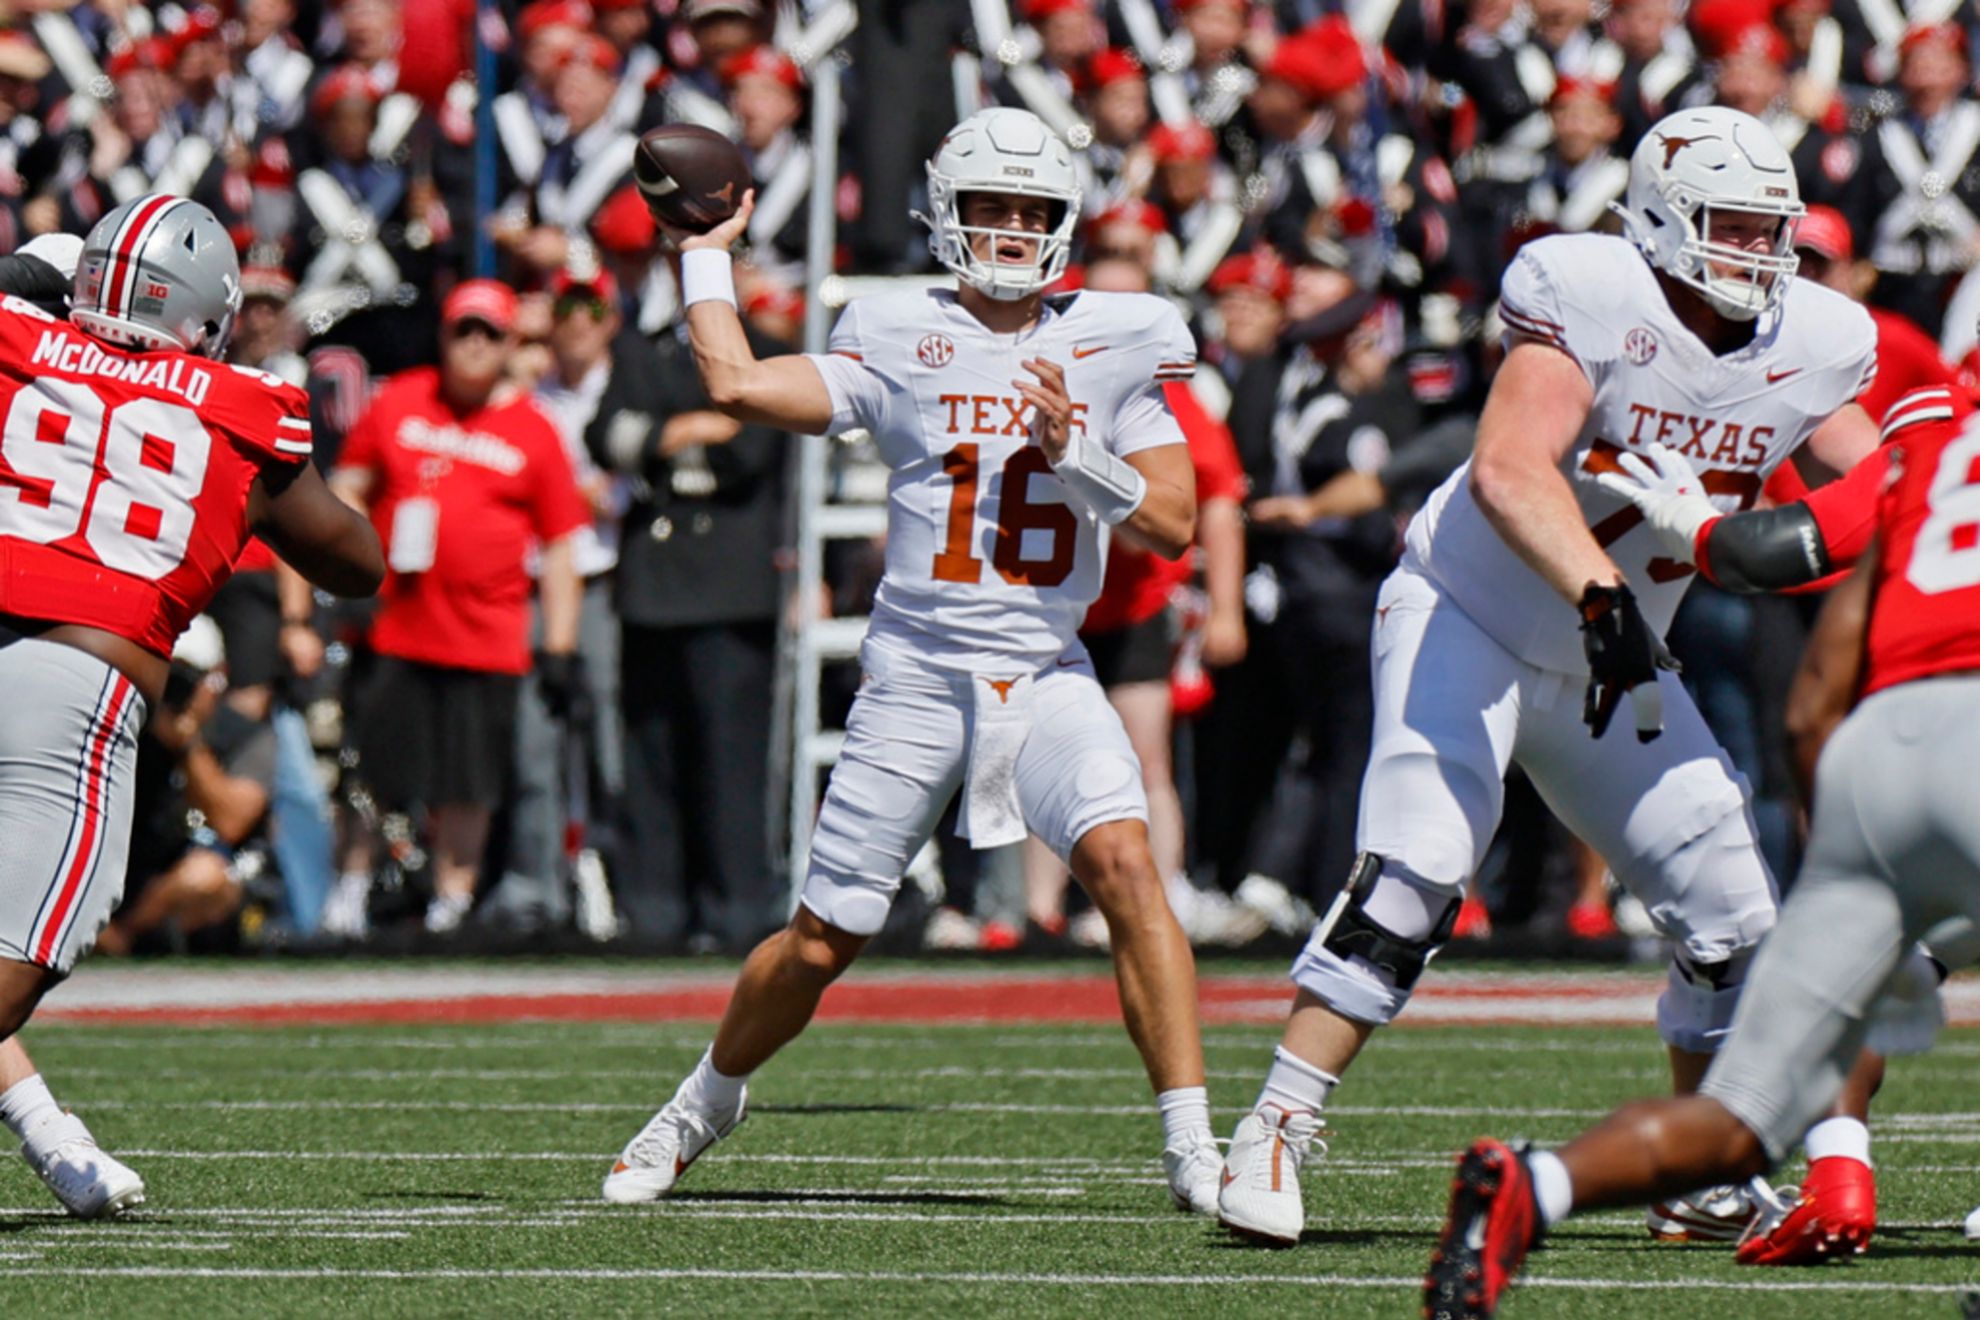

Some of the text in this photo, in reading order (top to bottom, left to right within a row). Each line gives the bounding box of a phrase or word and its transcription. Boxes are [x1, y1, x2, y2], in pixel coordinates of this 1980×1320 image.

[918, 334, 953, 368] SEC
[939, 394, 1088, 436] TEXS
[1627, 402, 1774, 466] TEXAS
[0, 375, 212, 581] 98
[932, 442, 1077, 587] 16
